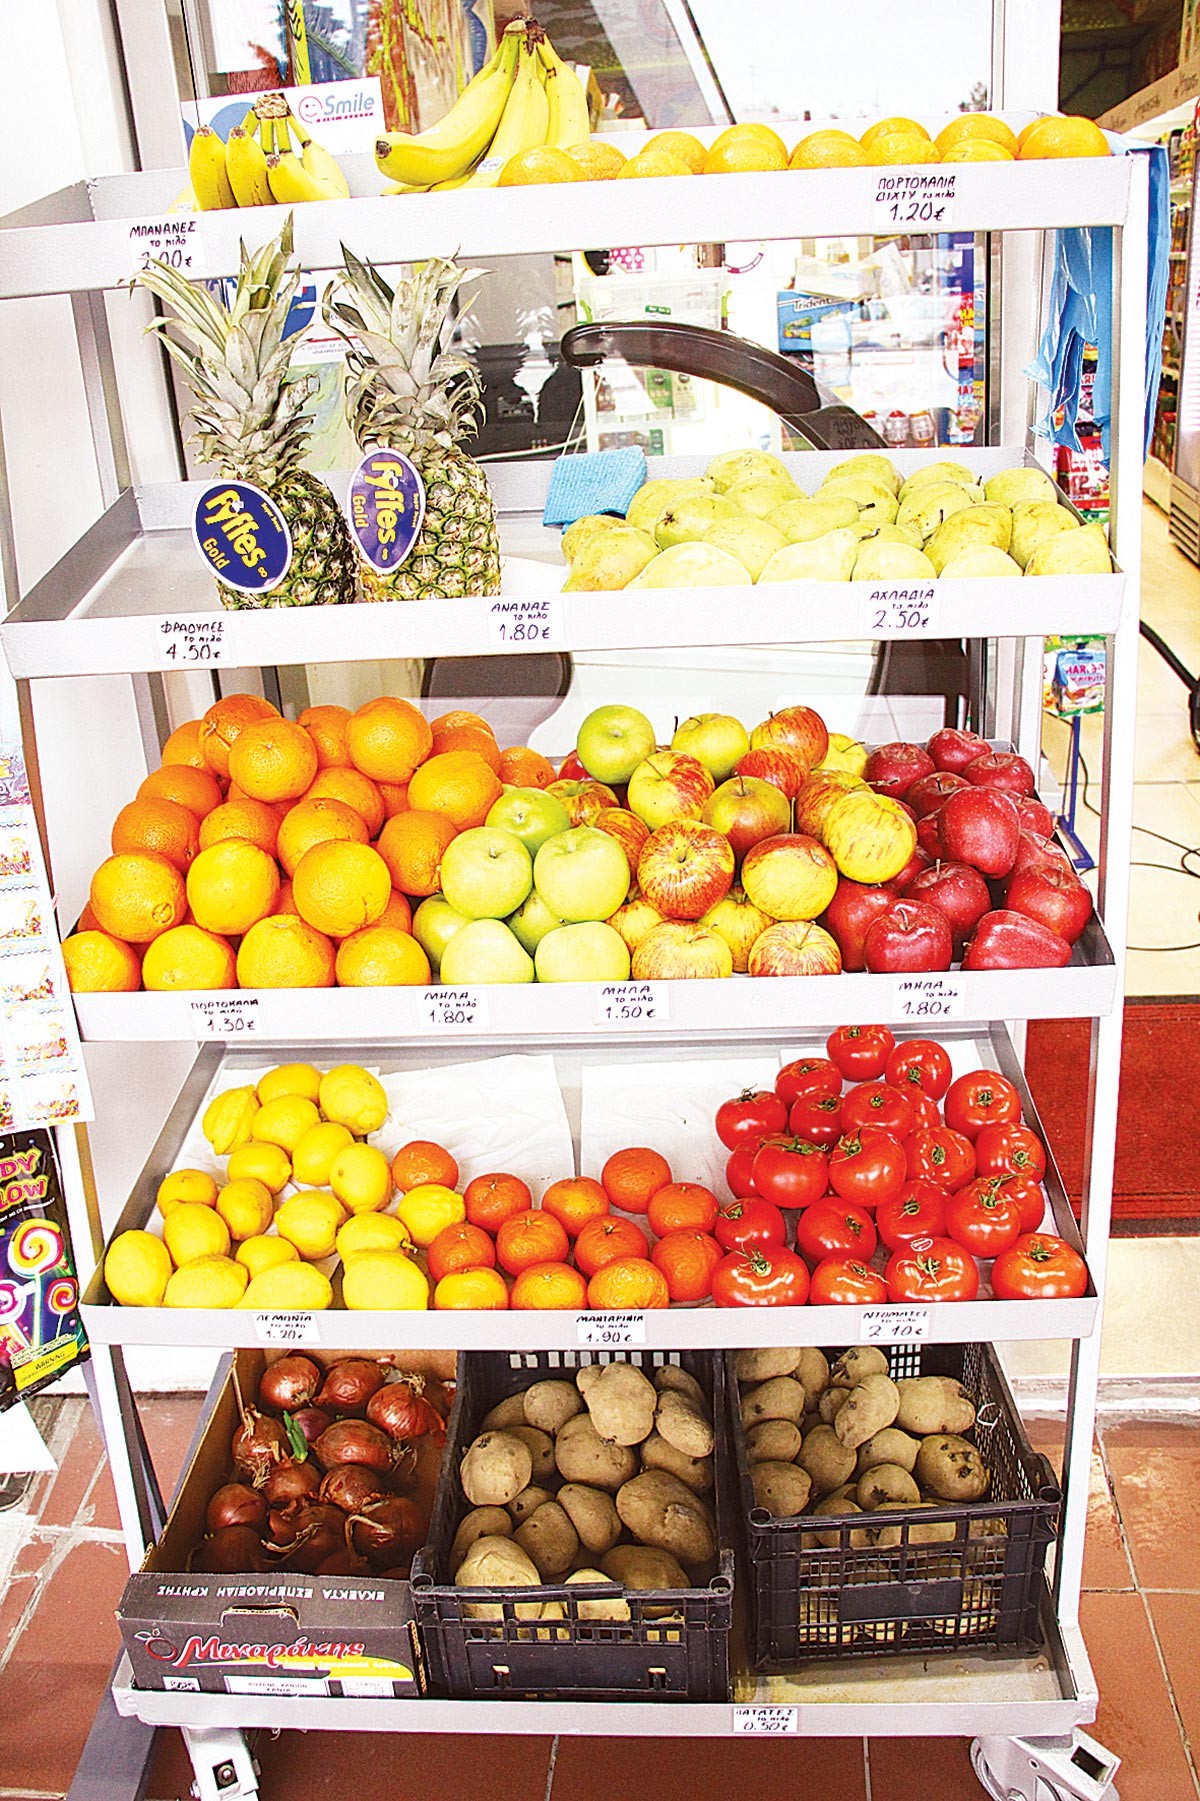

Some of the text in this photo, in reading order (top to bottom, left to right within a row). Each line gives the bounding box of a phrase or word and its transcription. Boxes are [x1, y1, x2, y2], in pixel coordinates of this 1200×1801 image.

[323, 92, 375, 116] Smile
[878, 175, 956, 190] ΠΟΡΤΟΚΑΛΙΑ
[889, 201, 946, 222] 1.20€
[129, 221, 197, 239] ΜΠΑΝΑΝΕΣ
[794, 298, 833, 310] Trident
[364, 461, 405, 545] Fyffes
[352, 494, 369, 529] Gold
[204, 489, 267, 568] Fyffes
[202, 537, 231, 570] Gold
[869, 589, 935, 601] ΑΧΛΑΔΙΑ
[491, 602, 551, 612] ΑΝΑΝΑΣ
[871, 610, 930, 629] 2.50€
[160, 621, 225, 634] ΦΡΑΟΥΛΕΣ
[499, 624, 551, 641] 1.80€
[166, 643, 221, 661] 4.50€
[602, 985, 651, 996] ΜΗΛΑ
[898, 980, 943, 991] ΜΗΛΑ
[423, 992, 469, 1000] ΜΗΛΑ
[190, 998, 260, 1010] ΠΟΡΤΟΚΑΛΙΑ
[902, 1001, 951, 1015] 1.80€
[429, 1009, 474, 1024] 1.80€
[605, 1005, 656, 1019] 1.50€
[207, 1017, 255, 1032] 1.30€
[157, 1585, 385, 1601] ΕΚΛΕΚΤΑ ΕΣΠΕΡΙΔΟΕΙΔΗ ΚΡΗΤΗΣ
